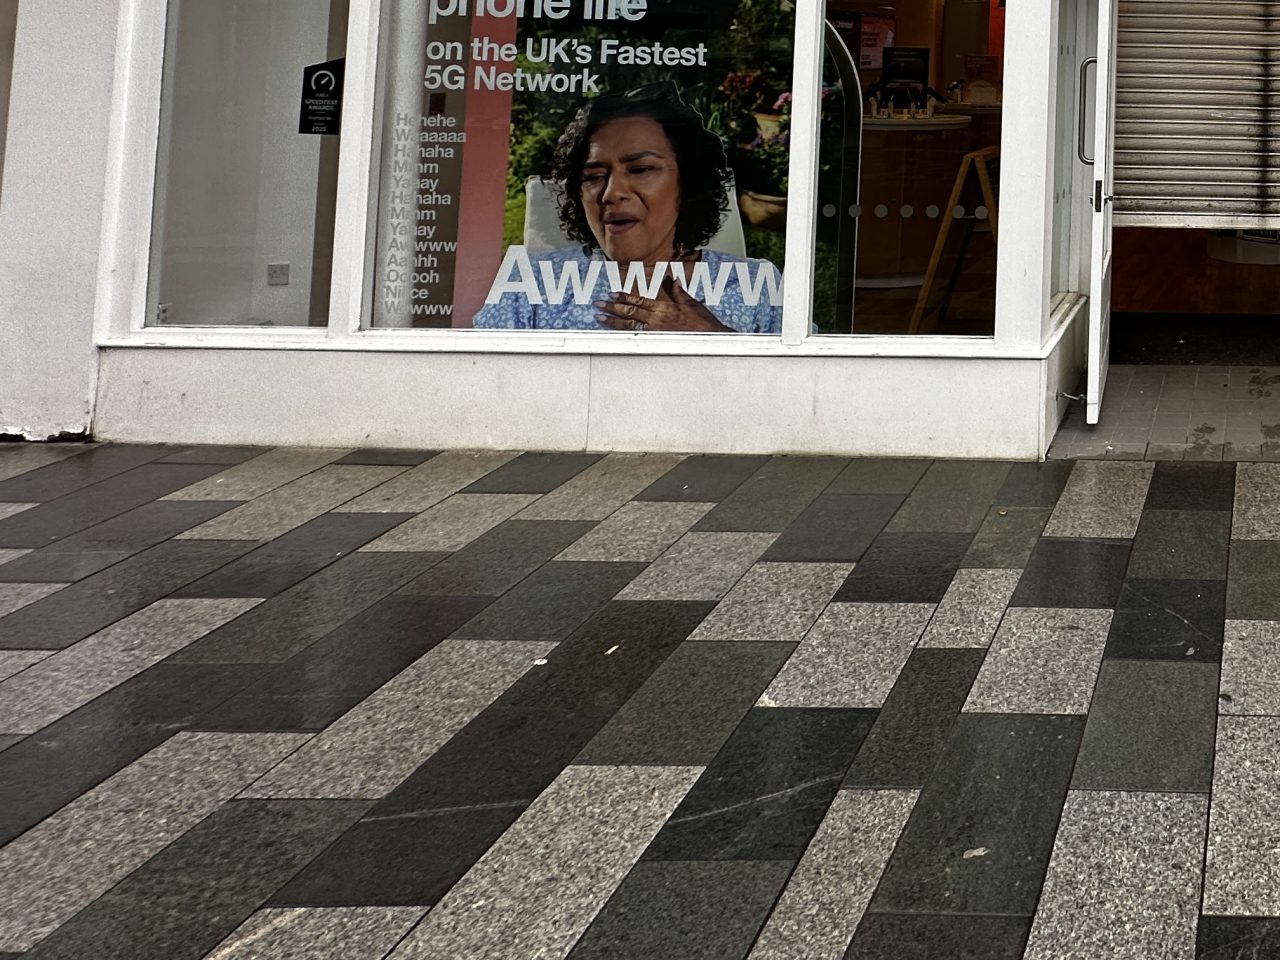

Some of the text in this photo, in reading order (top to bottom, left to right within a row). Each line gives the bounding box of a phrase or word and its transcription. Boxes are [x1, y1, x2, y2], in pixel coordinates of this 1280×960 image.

[427, 37, 707, 67] on the UK's Fastest
[424, 66, 599, 93] 5G Network
[395, 129, 467, 142] Waaaaa
[392, 175, 439, 192] Yaay
[390, 222, 436, 239] Yaay
[385, 285, 429, 299] Nice
[384, 300, 454, 315] Wwww
